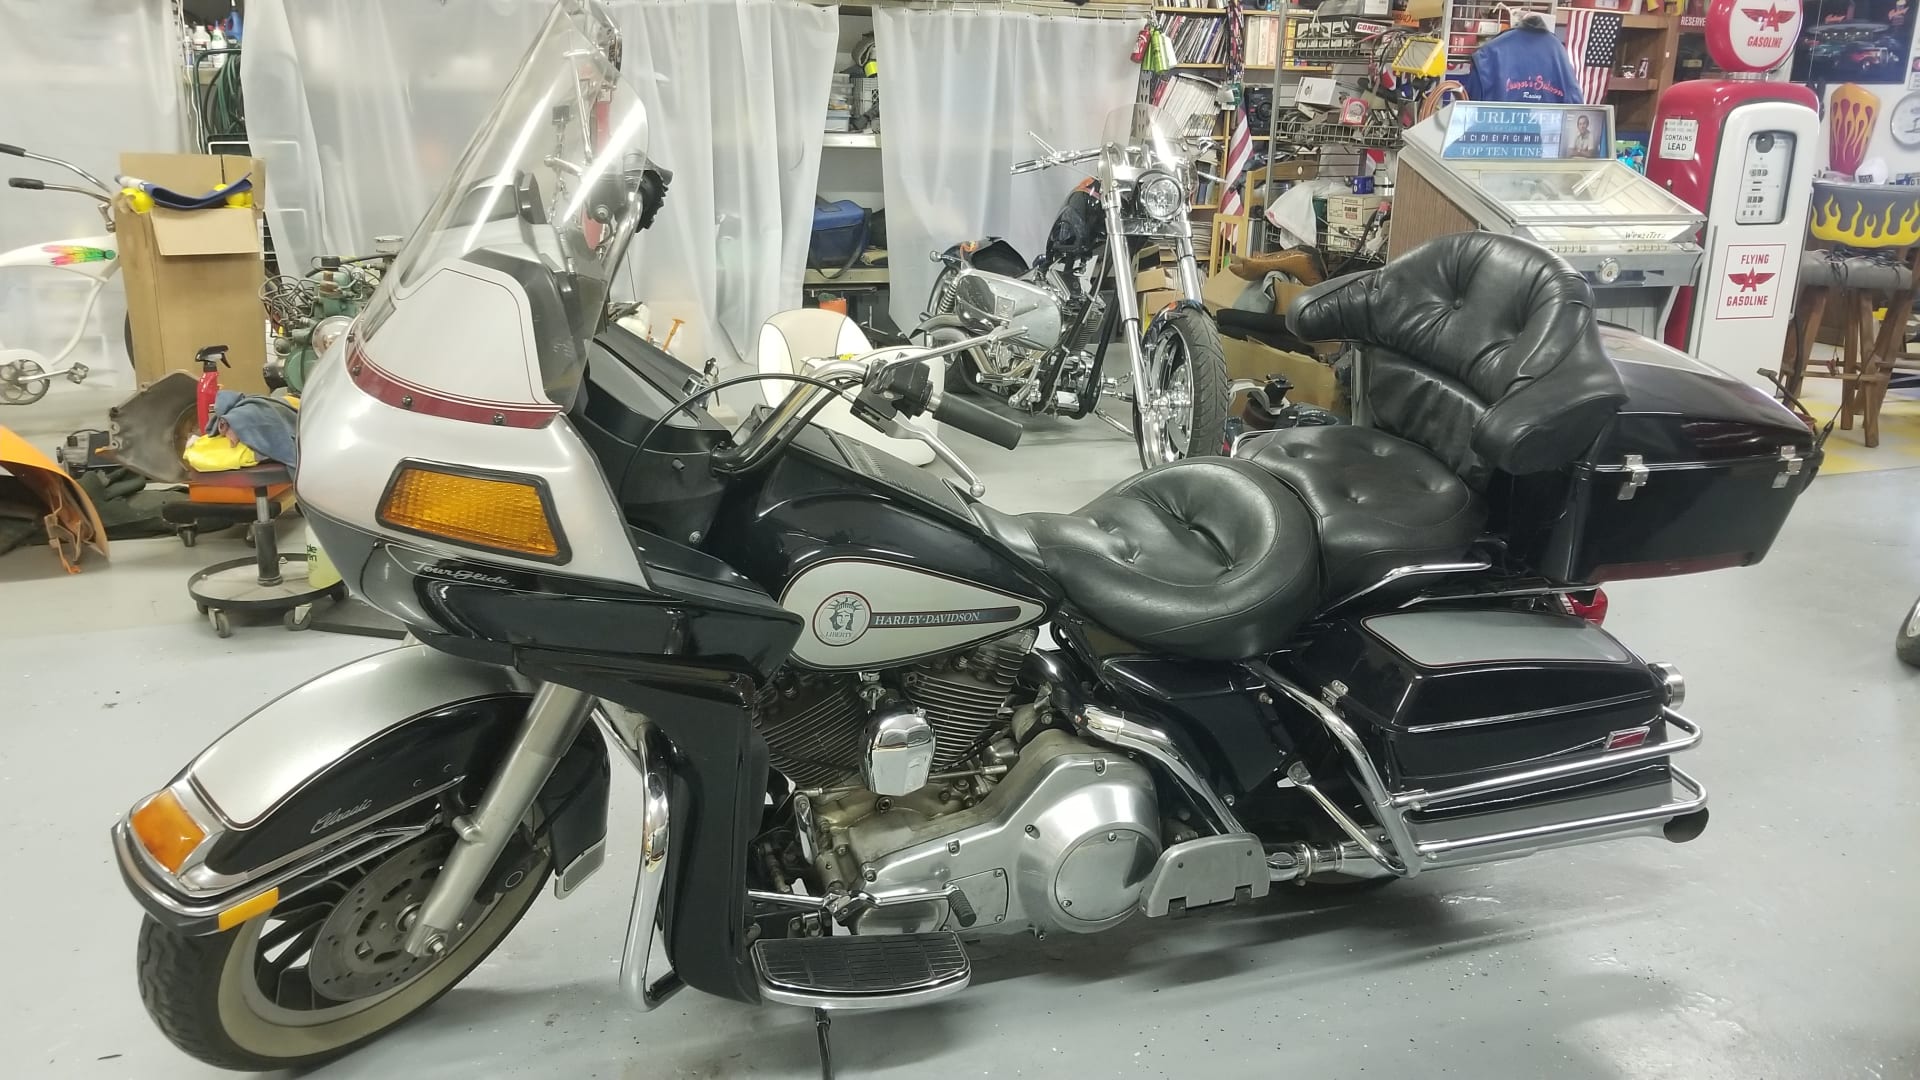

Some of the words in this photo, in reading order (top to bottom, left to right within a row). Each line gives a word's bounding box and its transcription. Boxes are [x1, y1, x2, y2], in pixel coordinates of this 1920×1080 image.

[1747, 36, 1783, 49] GASOLINE
[1523, 91, 1542, 101] Racing
[1665, 134, 1693, 142] CONTAINS
[1461, 146, 1483, 157] TOP
[1485, 146, 1508, 157] TEN
[1667, 143, 1687, 151] LEAD
[1740, 254, 1770, 265] FLYING
[1726, 295, 1769, 307] GASOLINE
[875, 611, 980, 626] HARLEY-DAVIDSON
